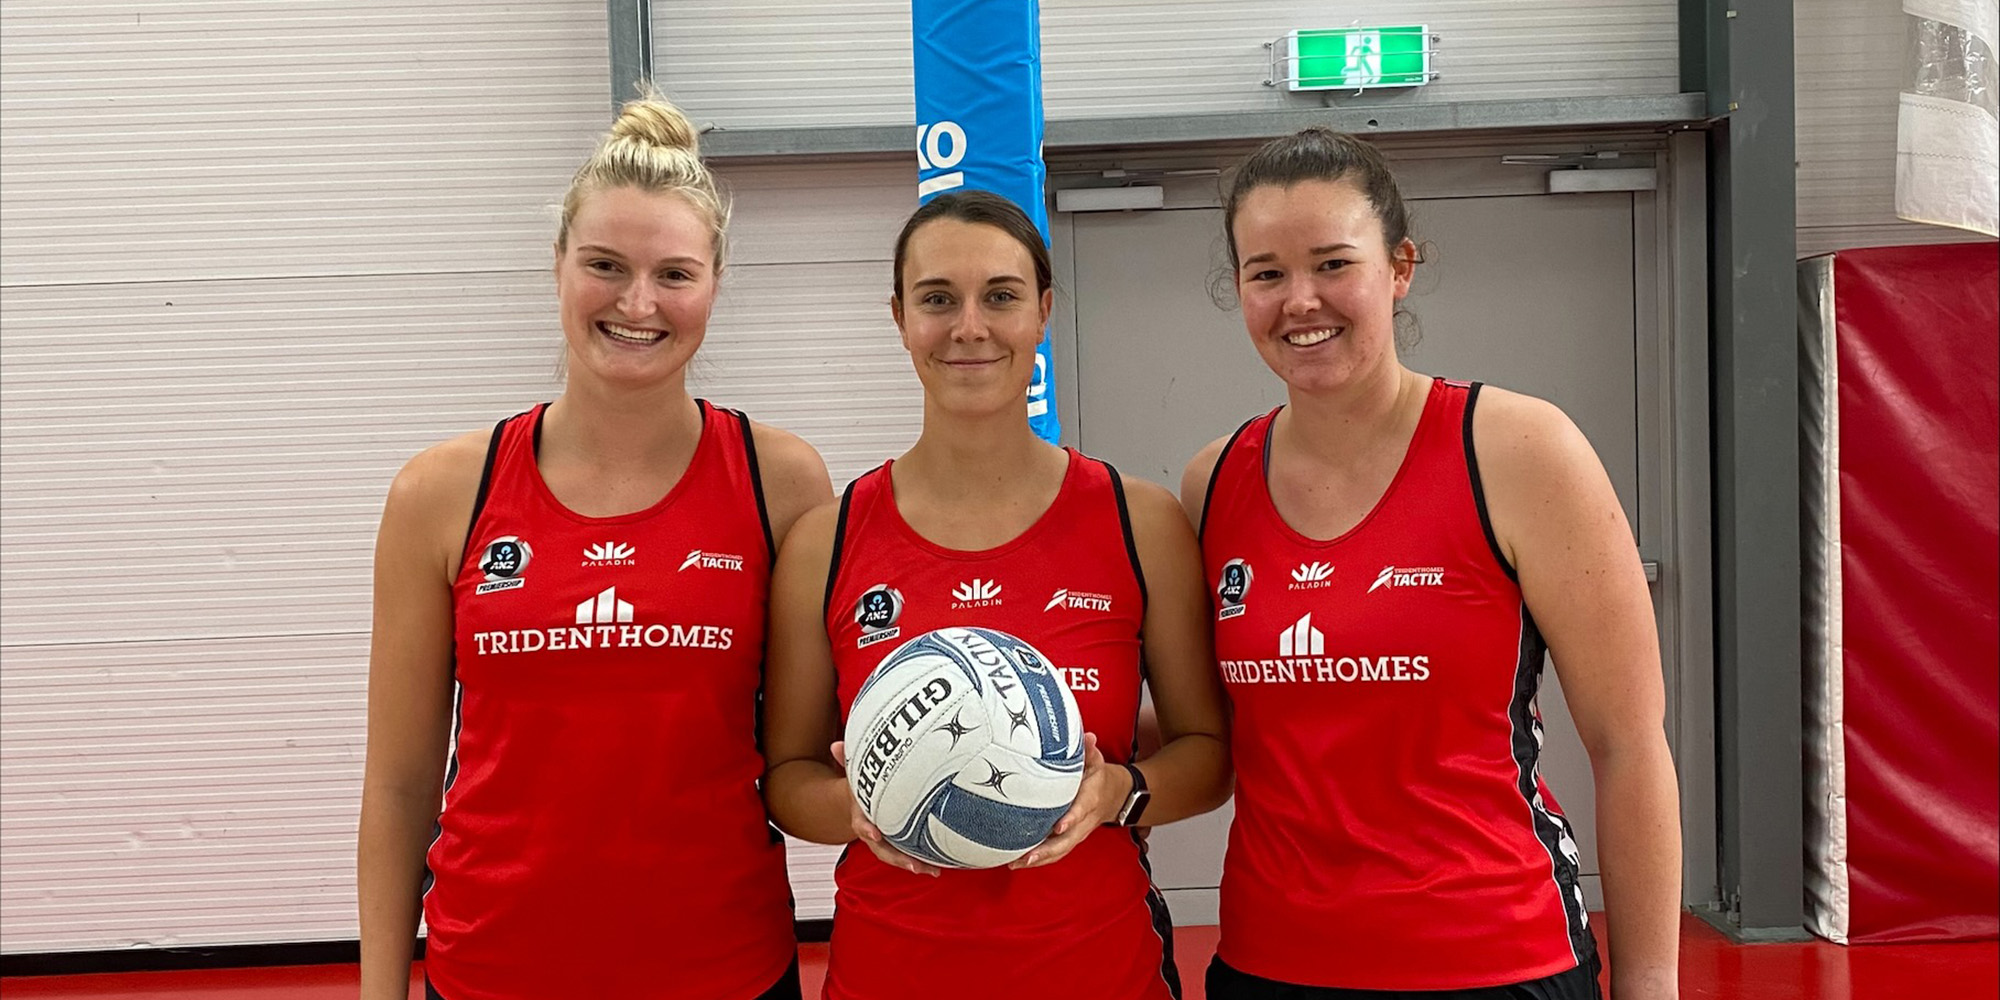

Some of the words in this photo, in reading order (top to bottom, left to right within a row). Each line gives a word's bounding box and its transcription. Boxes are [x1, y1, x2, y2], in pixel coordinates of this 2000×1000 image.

[490, 561, 515, 570] ANZ
[581, 559, 636, 567] PALADIN
[701, 557, 744, 571] TACTIX
[1288, 580, 1332, 591] PALADIN
[1392, 573, 1444, 587] TACTIX
[951, 598, 1003, 610] PALADIN
[1067, 596, 1112, 612] TACTIX
[865, 610, 889, 622] ANZ
[474, 624, 734, 655] TRIDENTHOMES
[858, 629, 898, 646] PREMIERSHIP
[953, 632, 1017, 699] TACTIX
[1220, 656, 1430, 684] TRIDENTHOMES
[857, 677, 952, 817] GILBERT
